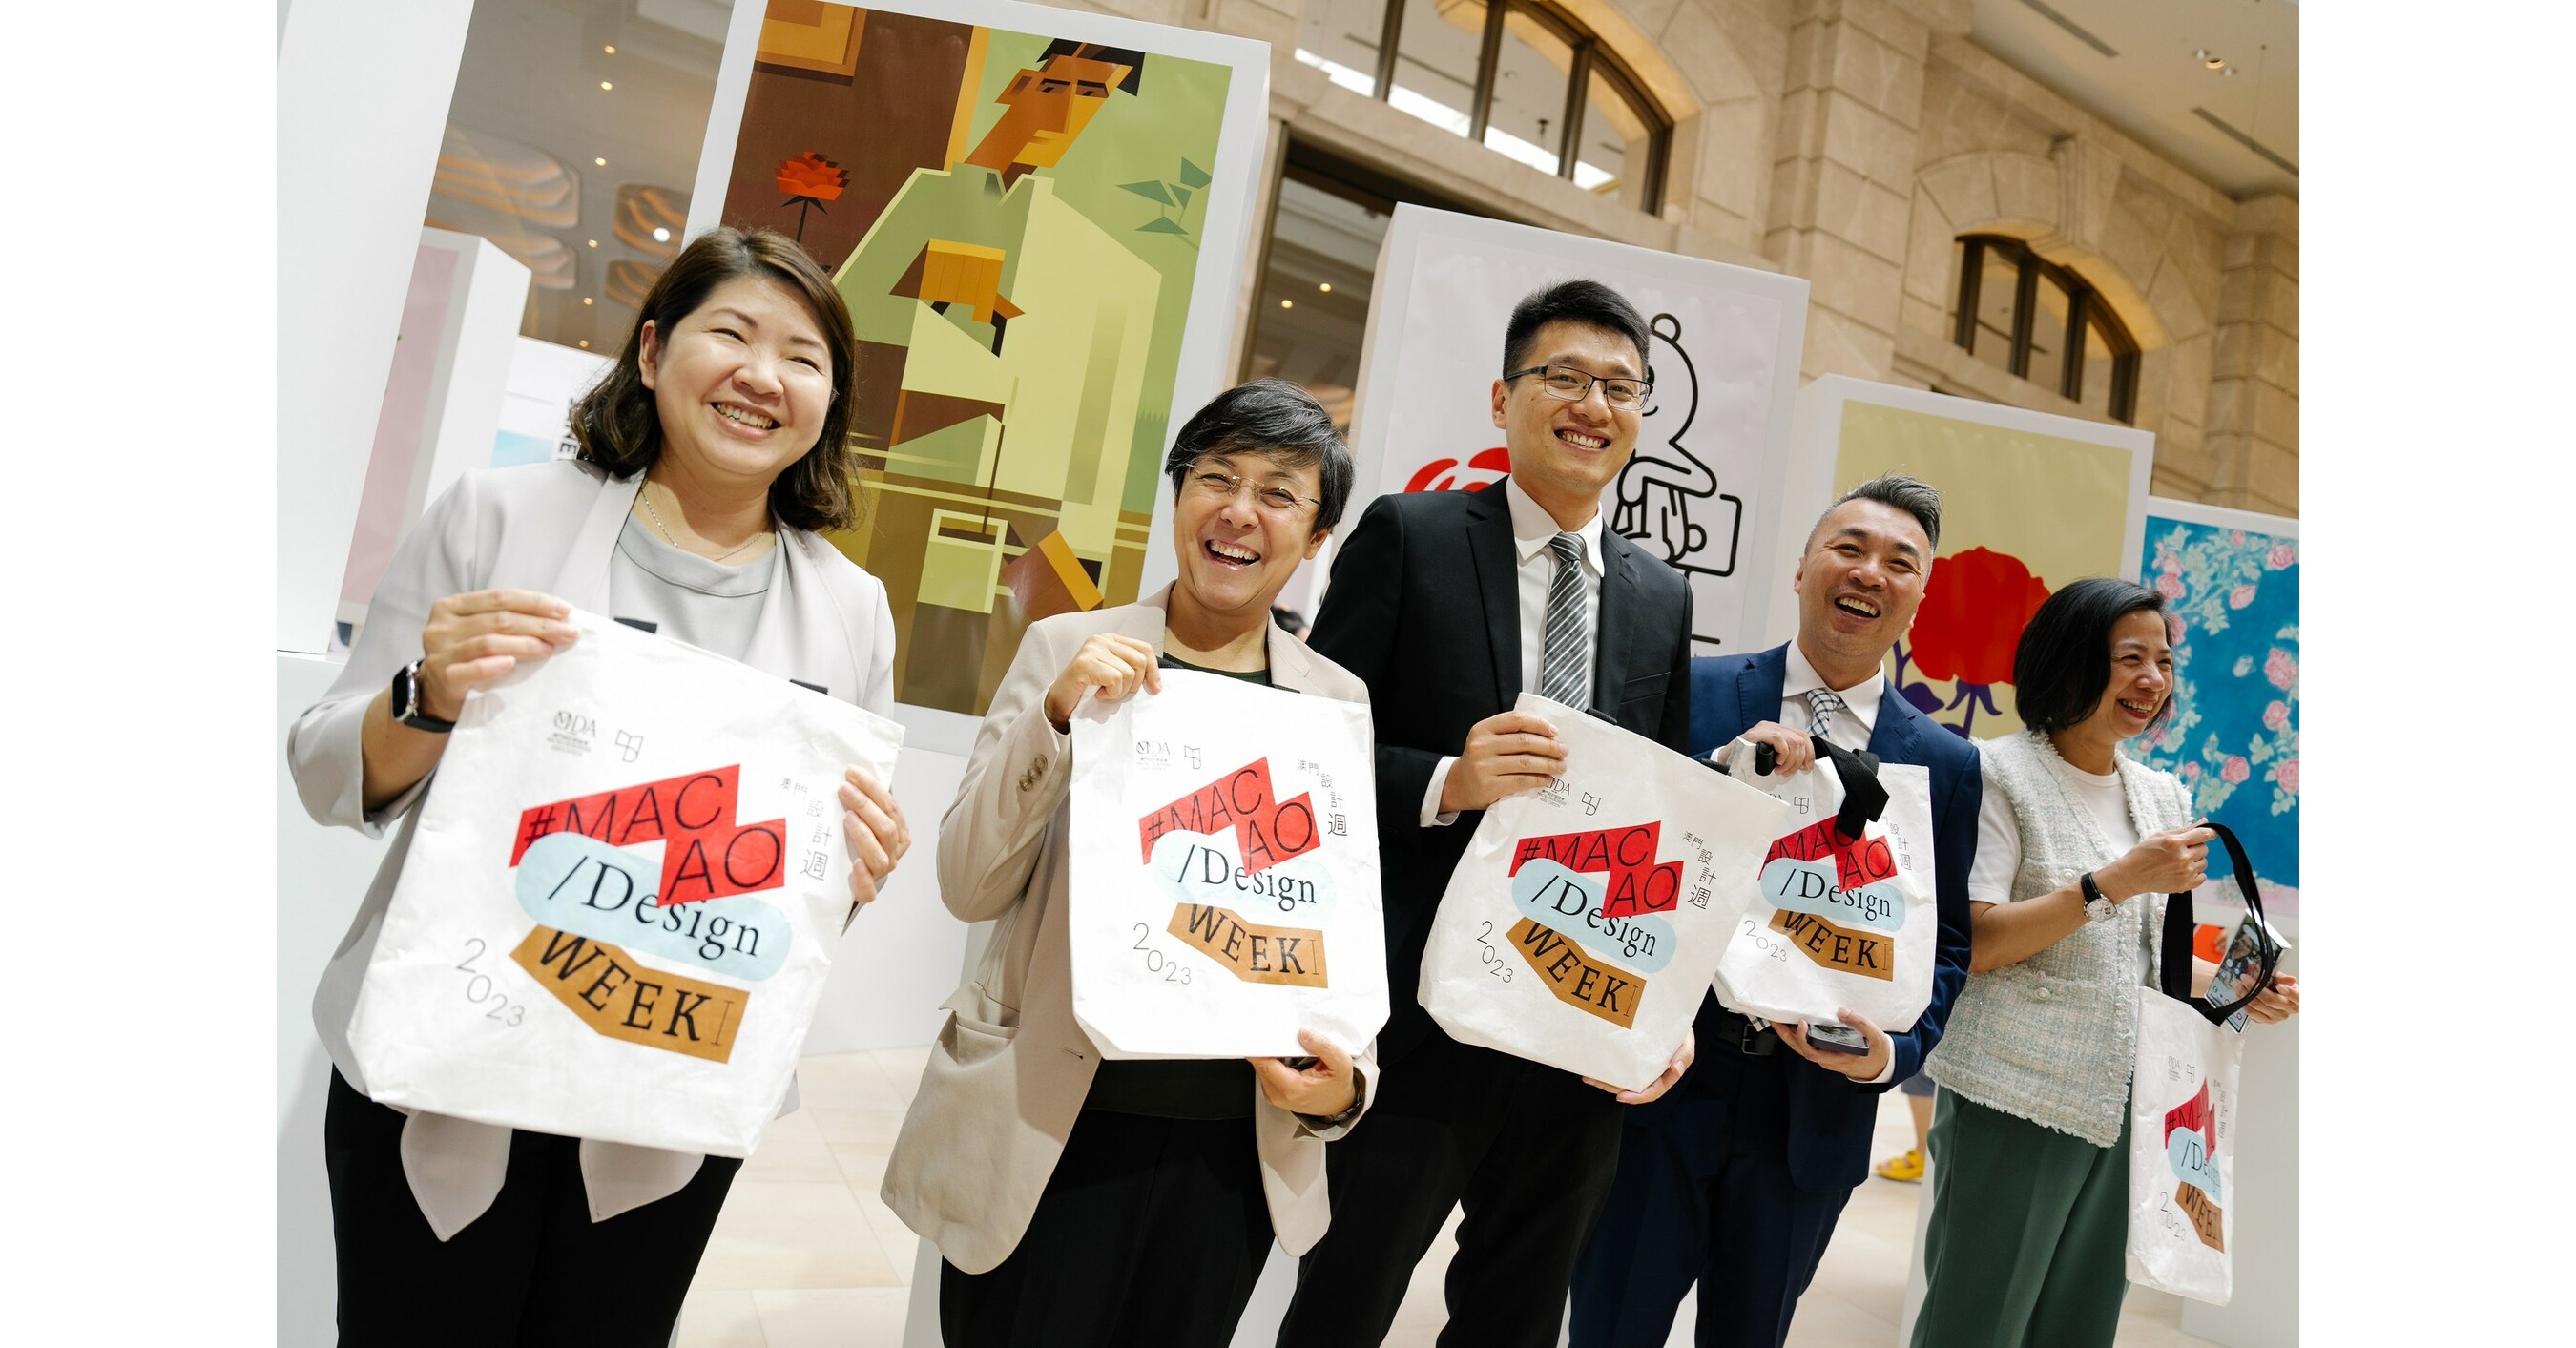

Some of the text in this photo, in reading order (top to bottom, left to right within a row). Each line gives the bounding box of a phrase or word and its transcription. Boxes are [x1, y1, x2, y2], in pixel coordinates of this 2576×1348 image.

[666, 827, 780, 900] AO
[1248, 802, 1313, 870] AO
[1842, 840, 1892, 888] AO
[548, 856, 760, 960] /Design
[1177, 844, 1317, 911] /Design
[1608, 865, 1678, 914] AO
[1779, 868, 1891, 922] /Design
[1530, 875, 1656, 958] /Design
[1744, 920, 1787, 962] 2023
[456, 938, 525, 1027] 2023
[1133, 923, 1192, 985] 2023
[1477, 921, 1514, 983] 2023
